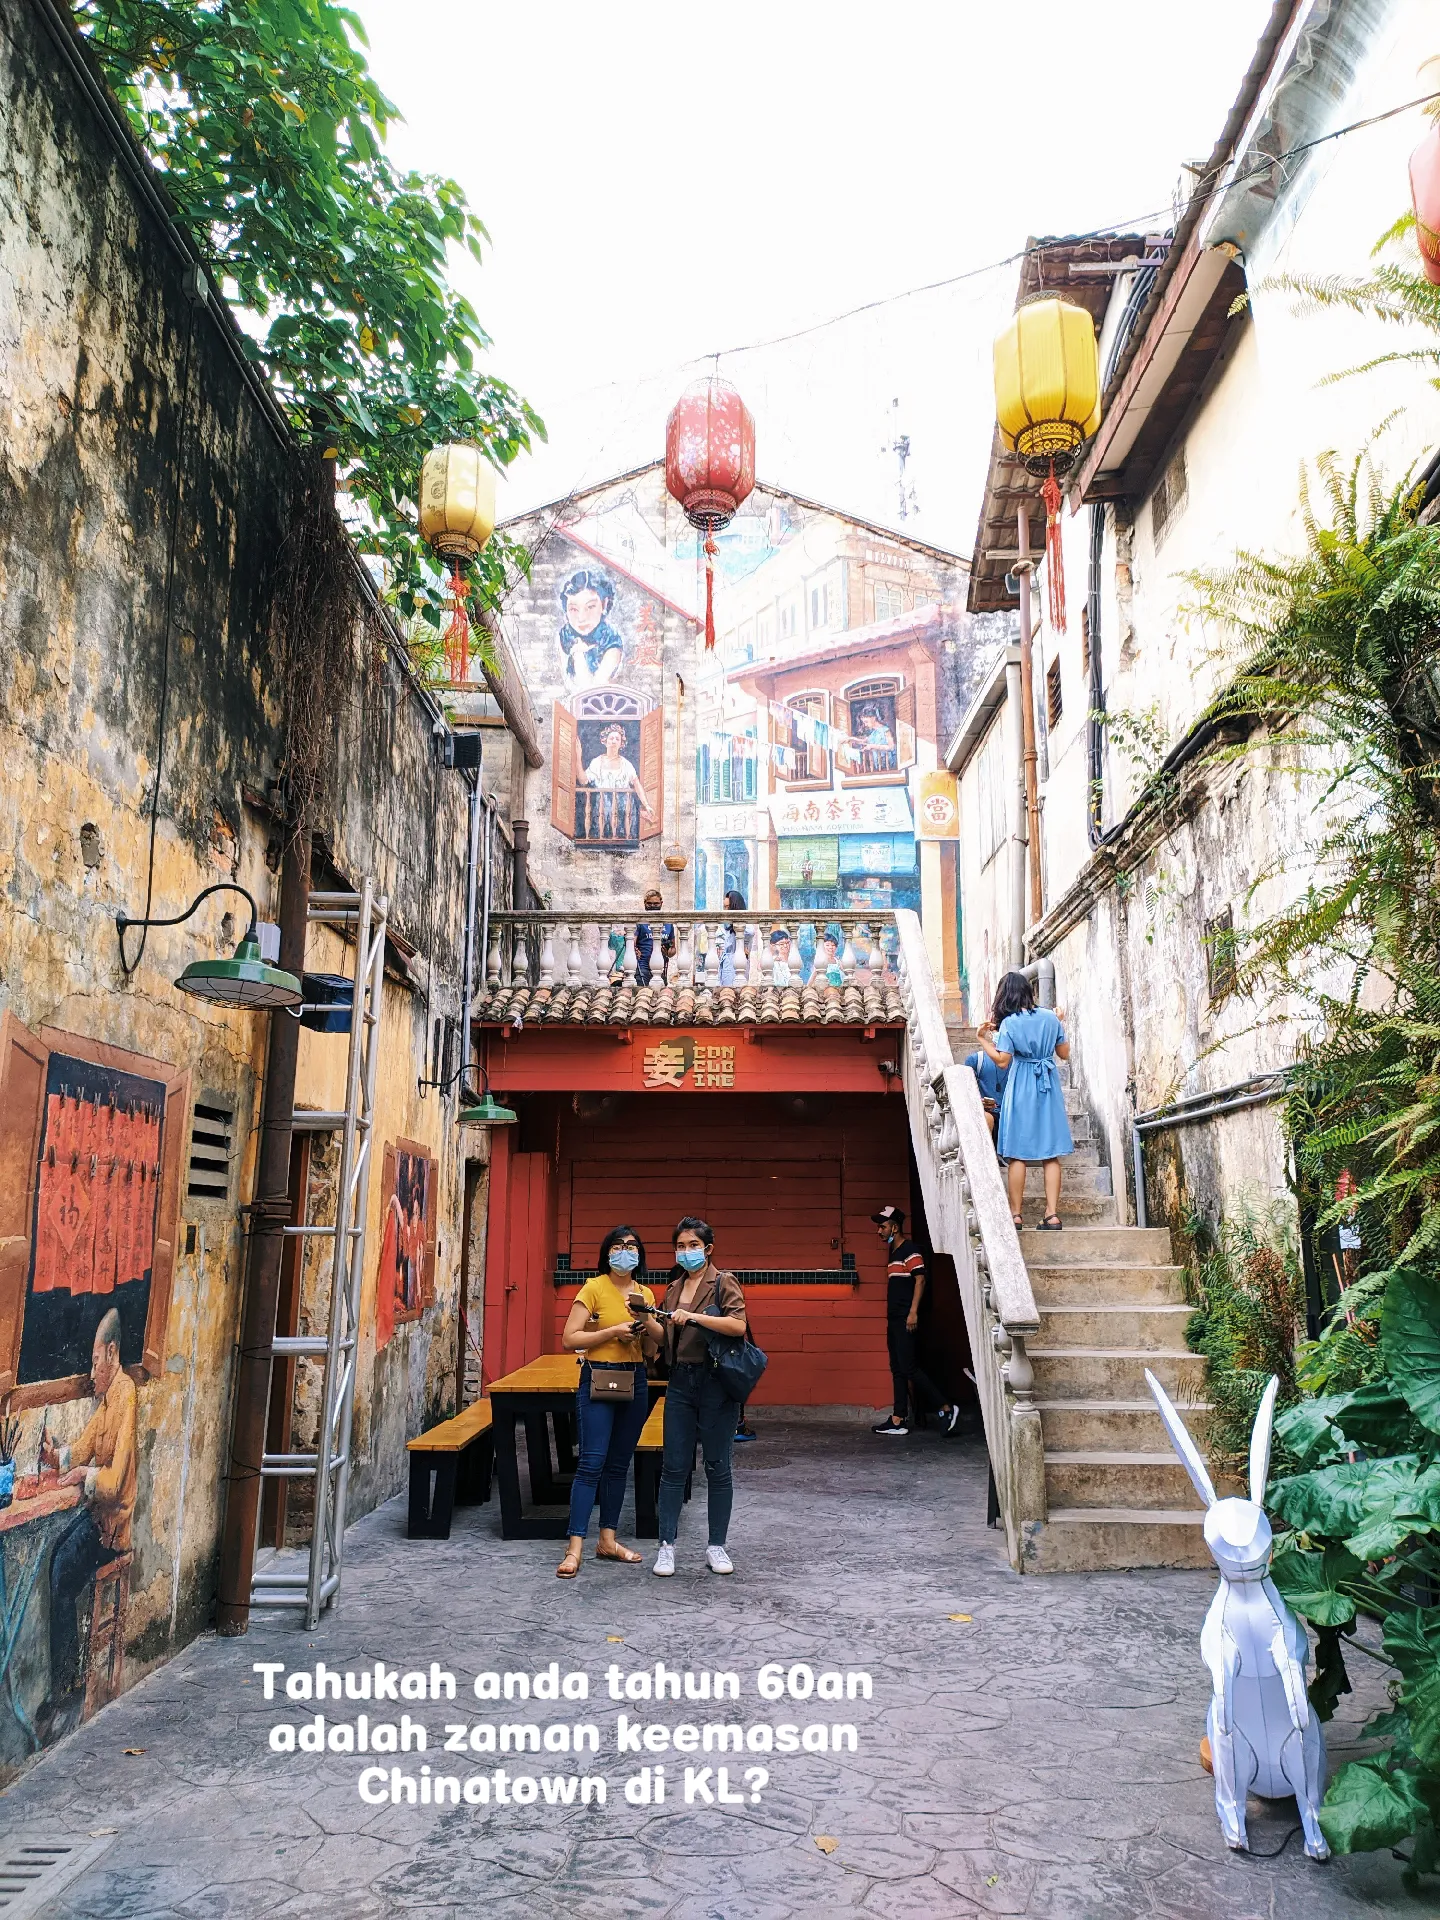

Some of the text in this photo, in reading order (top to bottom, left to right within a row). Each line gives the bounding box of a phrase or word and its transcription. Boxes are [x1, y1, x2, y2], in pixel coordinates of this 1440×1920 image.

[781, 796, 865, 823] 海南茶室
[926, 798, 949, 822] 當
[692, 1045, 736, 1059] CON
[692, 1073, 736, 1087] INE
